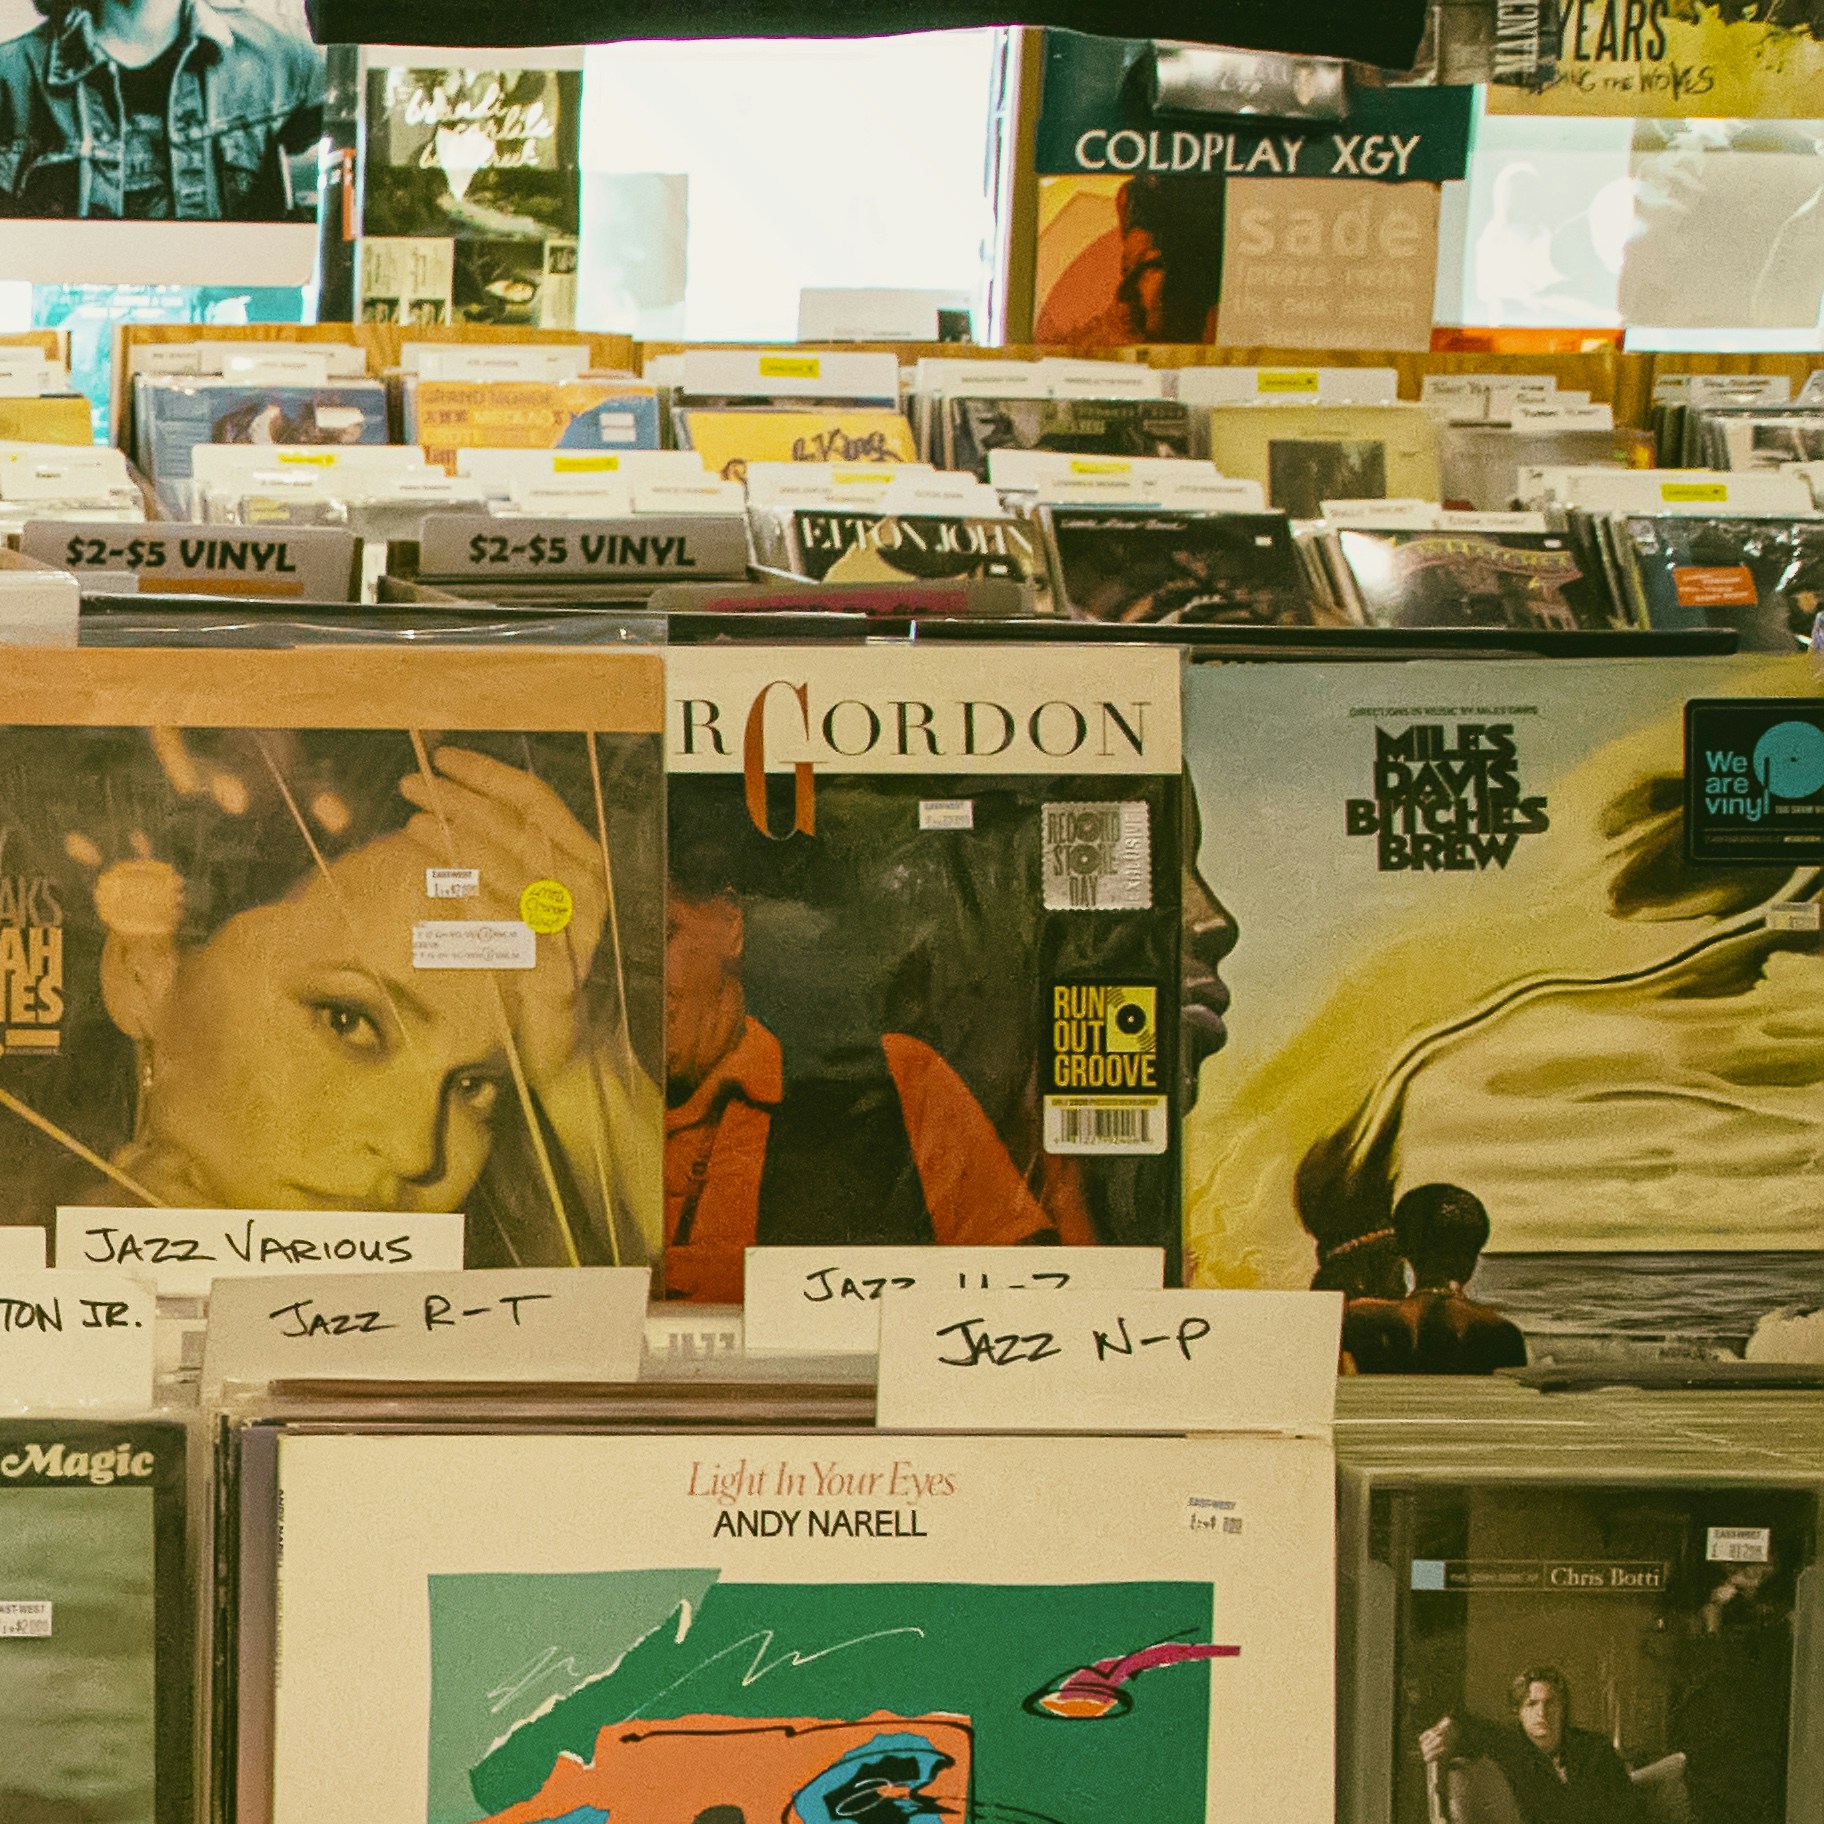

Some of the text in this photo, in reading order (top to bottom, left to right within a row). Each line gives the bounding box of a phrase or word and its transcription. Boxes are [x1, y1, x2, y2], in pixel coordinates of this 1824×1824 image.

[1074, 128, 1422, 176] COLDPLAY X&Y
[1237, 196, 1422, 258] sade
[65, 535, 297, 573] $2-$5 VINYL
[468, 531, 697, 568] $2-$5 VINYL
[801, 516, 1034, 556] ELTON JOHN
[1374, 723, 1517, 763] MILES
[1704, 749, 1749, 776] We
[1371, 759, 1521, 801] DAVIS
[1704, 774, 1749, 796] are
[1345, 796, 1550, 837] BITCHES
[1704, 788, 1771, 823] vinyl
[1377, 833, 1519, 872] BREW
[1054, 987, 1104, 1019] RUN
[1054, 1021, 1104, 1053] OUT
[1054, 1055, 1157, 1088] GROOVE
[84, 1223, 414, 1266] JAZZ VARIOUS
[79, 1299, 145, 1332] JR.
[269, 1293, 555, 1339] JAZZ R-T
[935, 1316, 1213, 1368] JAZZ N-P
[2, 1443, 155, 1487] Magic
[687, 1460, 958, 1503] Light In Your Eyes
[713, 1508, 929, 1539] ANDY NARELL
[1550, 1566, 1606, 1587] Chris
[1610, 1566, 1662, 1587] Botti
